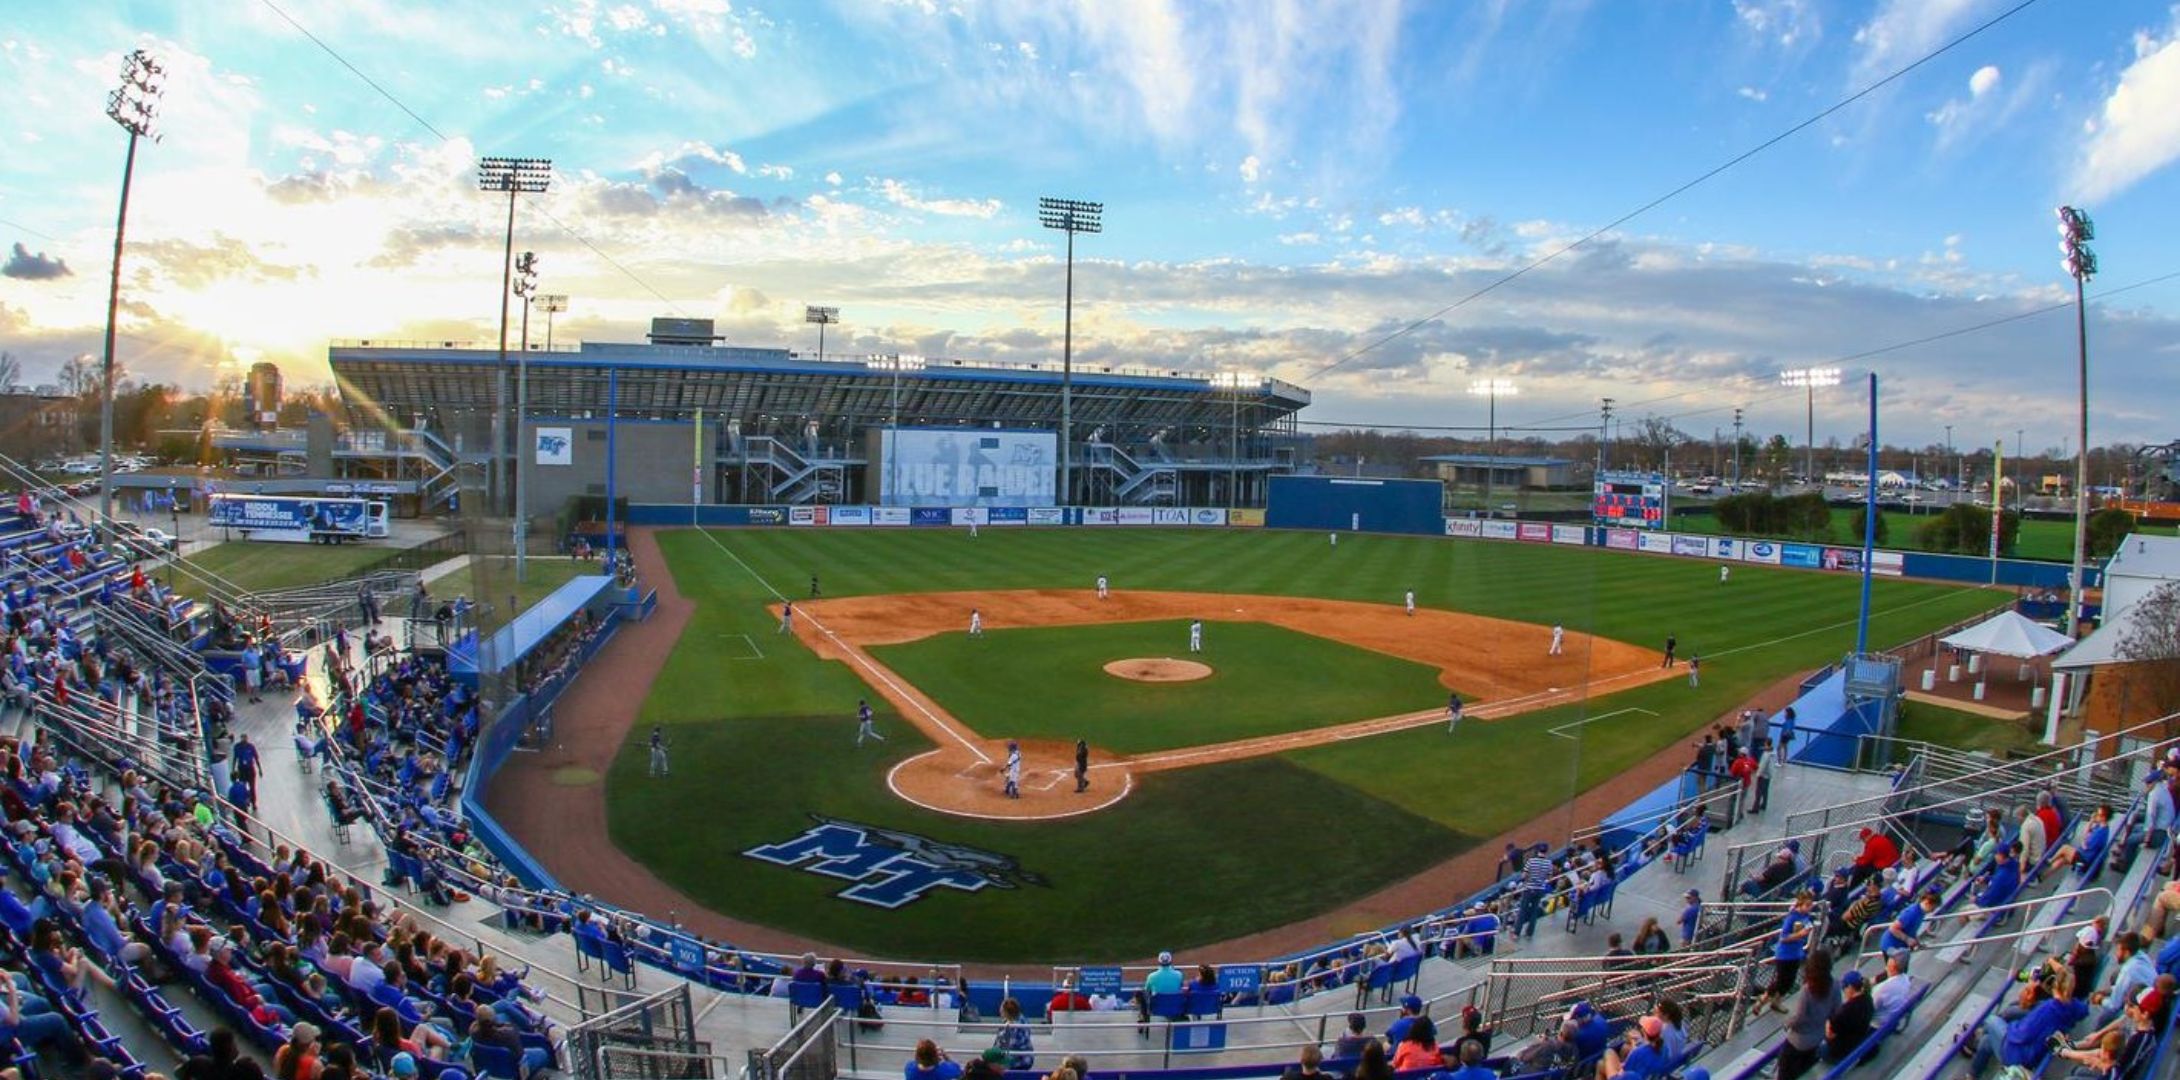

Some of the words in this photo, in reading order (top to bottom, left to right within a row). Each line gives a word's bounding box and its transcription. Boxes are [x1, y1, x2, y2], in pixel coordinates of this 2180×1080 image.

[245, 502, 278, 511] MIDDLE
[246, 511, 293, 519] TENNESSEE
[1448, 521, 1479, 533] xfinity
[742, 824, 989, 909] MT
[1224, 967, 1256, 975] SECTION
[1229, 976, 1251, 989] 102
